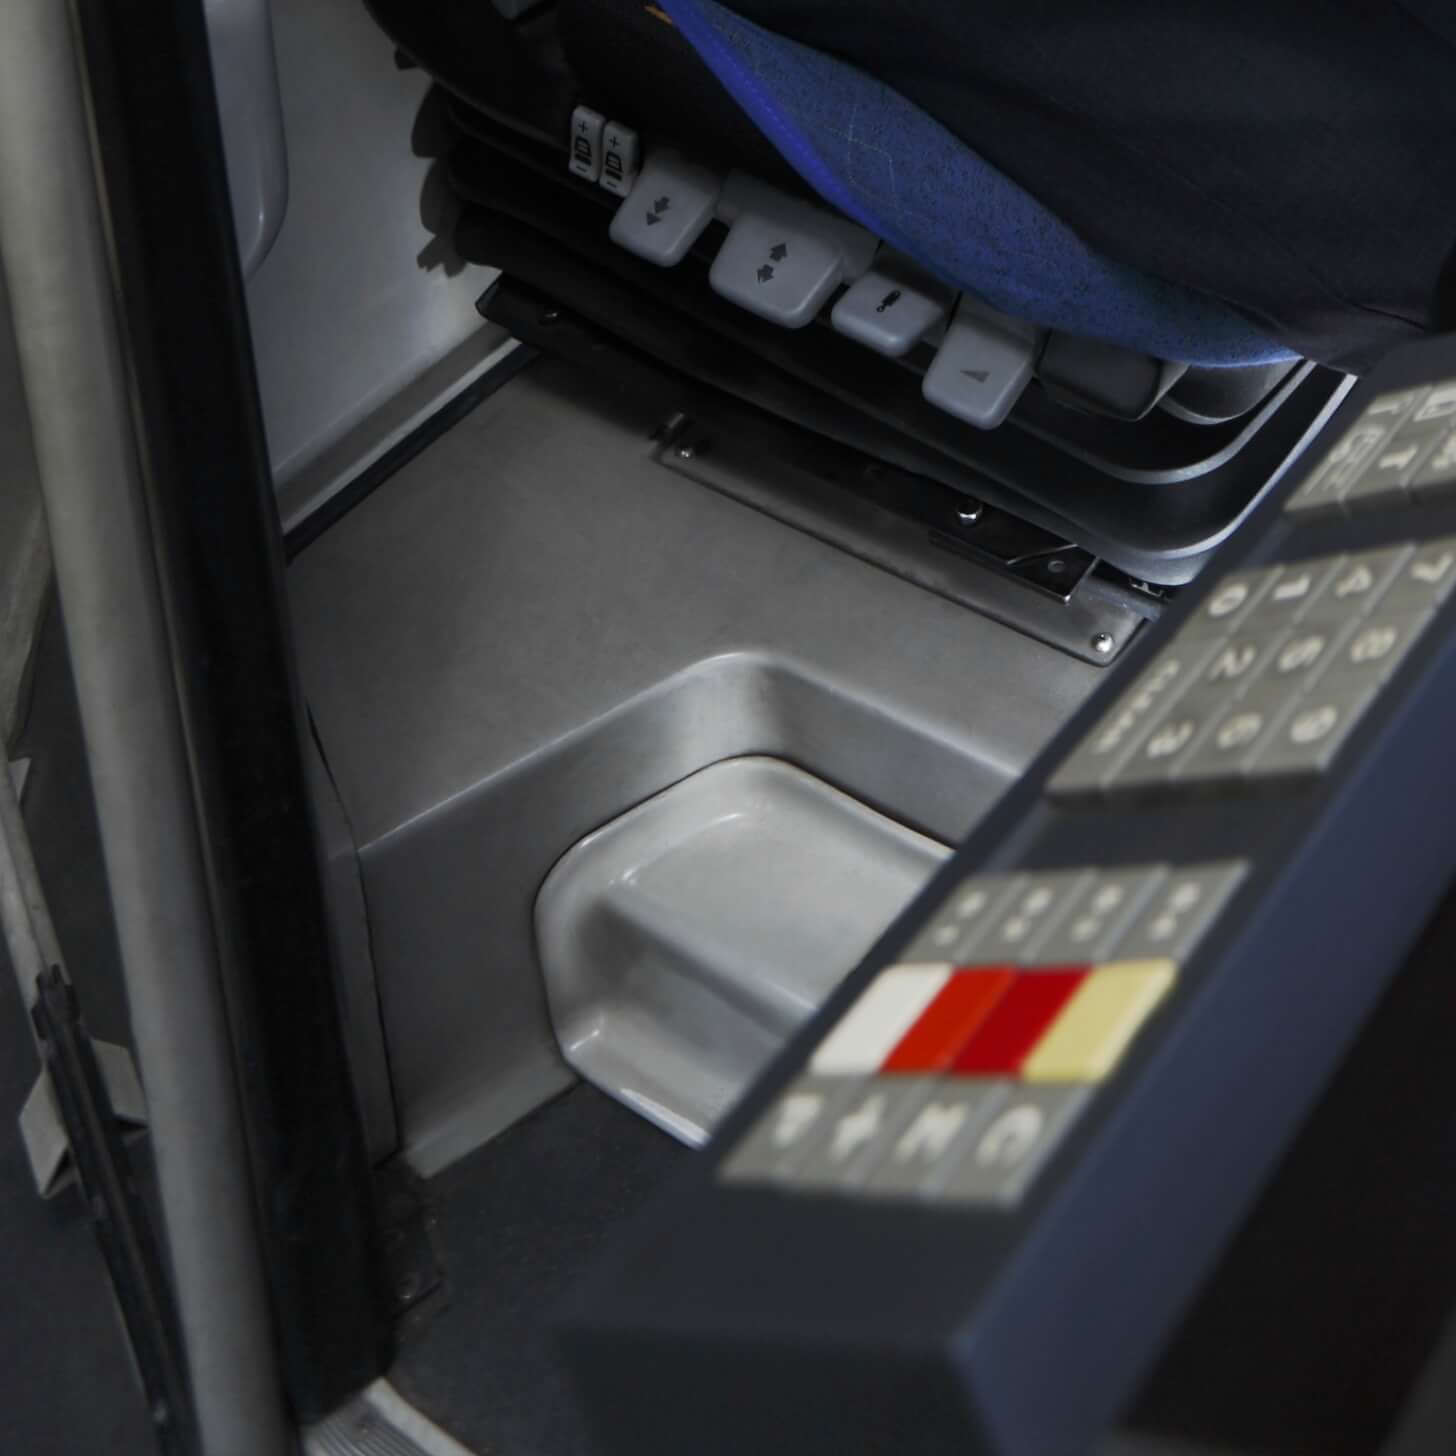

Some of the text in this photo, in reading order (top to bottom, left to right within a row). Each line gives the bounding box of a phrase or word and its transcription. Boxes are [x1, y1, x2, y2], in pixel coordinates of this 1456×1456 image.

[1208, 583, 1249, 617] 0
[1278, 635, 1325, 673] 5
[1289, 553, 1455, 743] 7 8 9
[1147, 574, 1311, 759] 1 2 3
